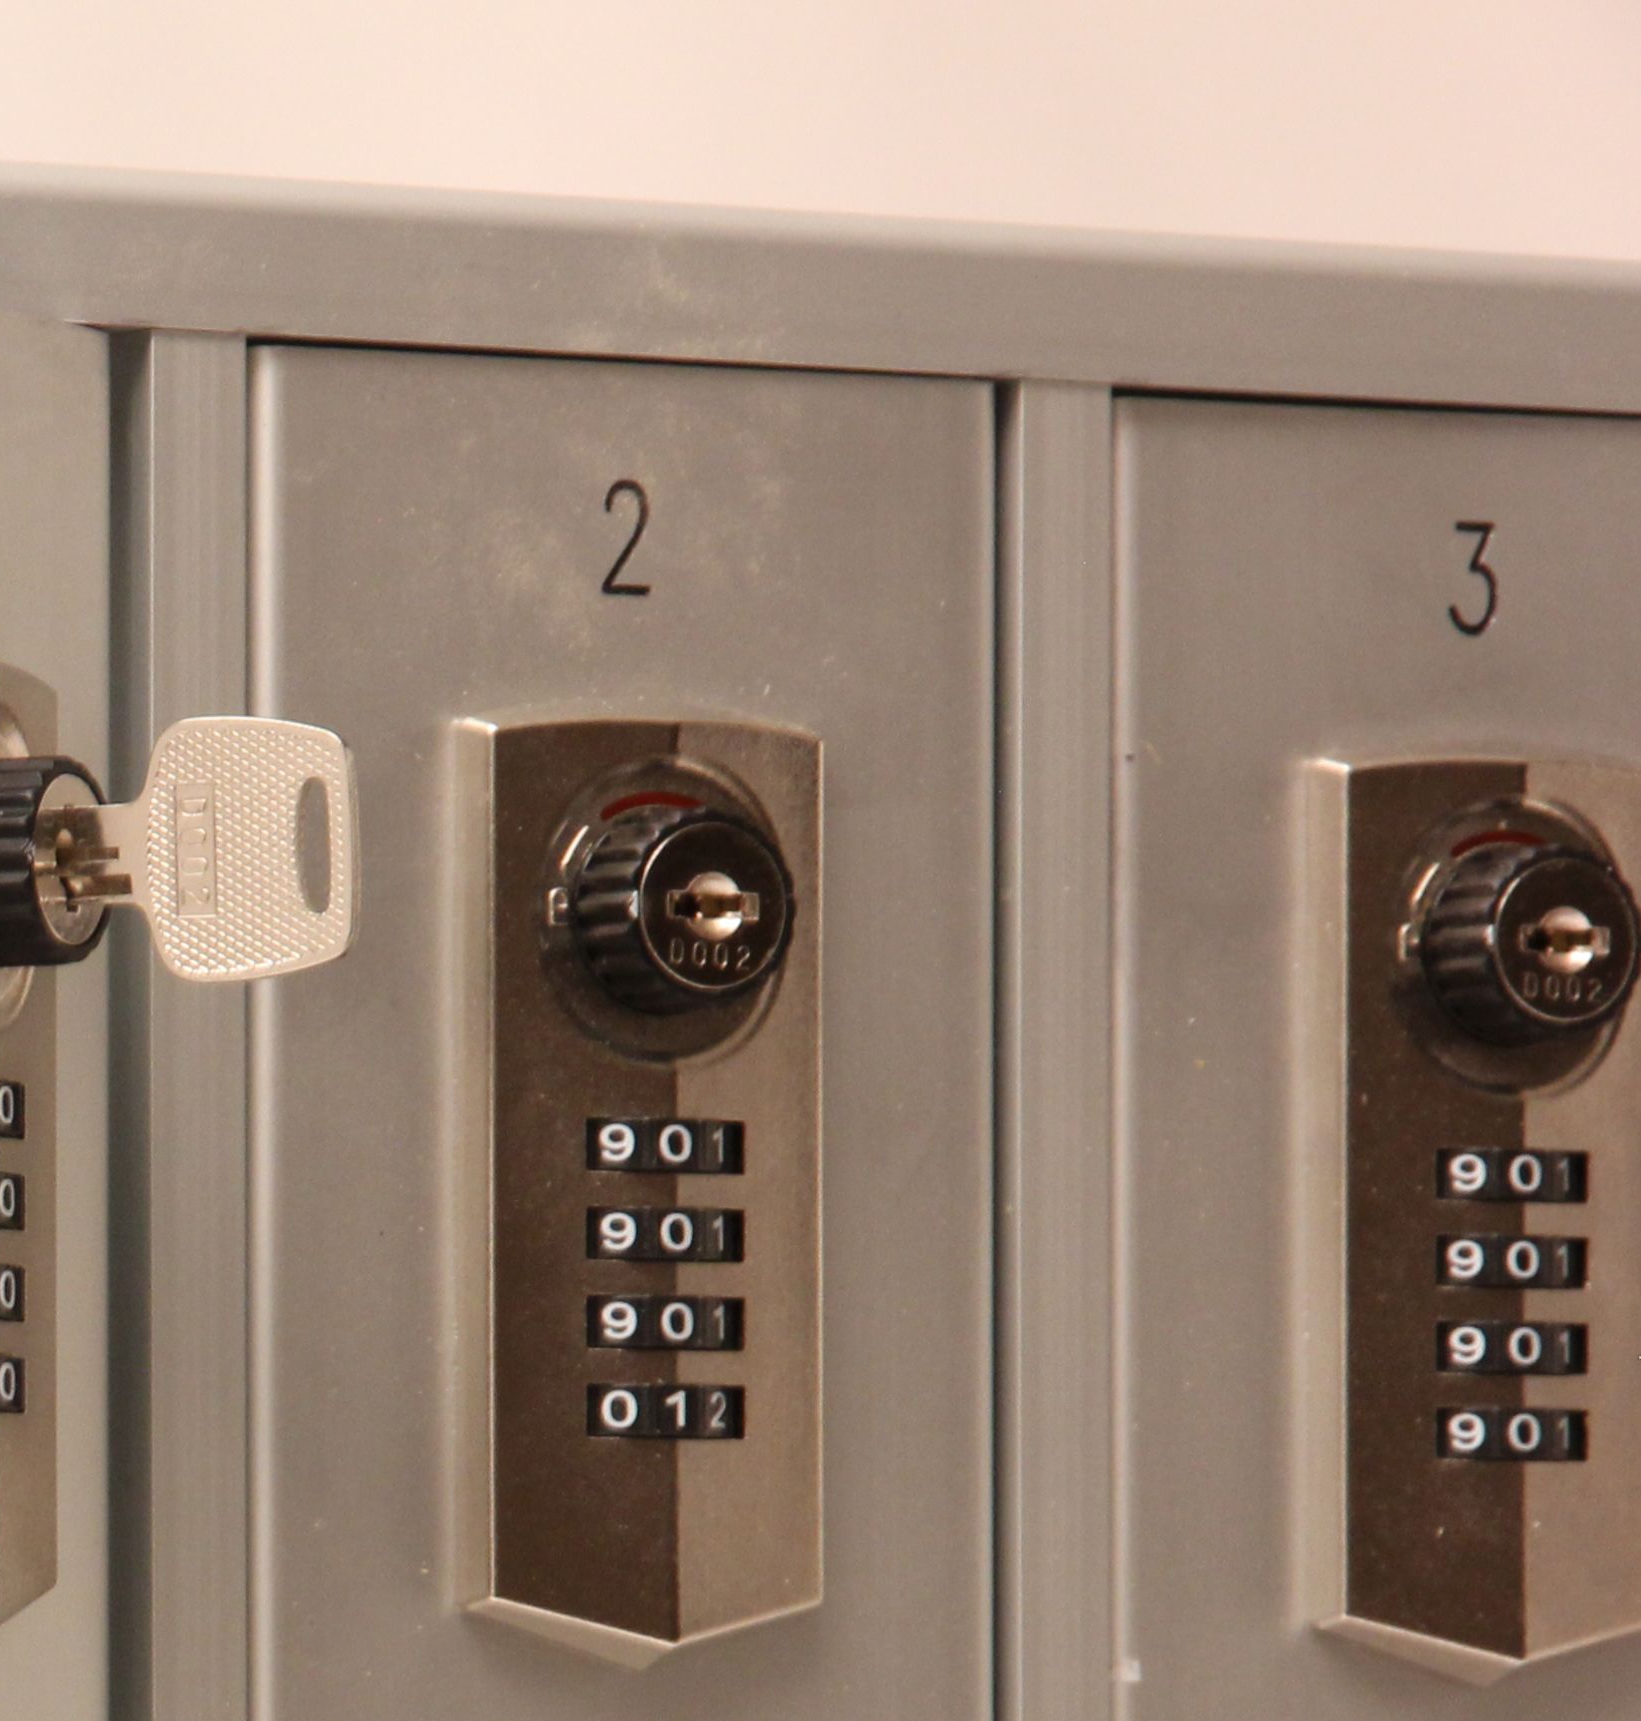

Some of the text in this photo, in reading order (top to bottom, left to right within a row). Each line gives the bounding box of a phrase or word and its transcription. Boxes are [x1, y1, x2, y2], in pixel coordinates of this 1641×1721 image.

[602, 479, 650, 595] 2
[1449, 521, 1498, 637] 3
[598, 1123, 724, 1164] 901
[599, 1212, 725, 1253] 901
[600, 1301, 725, 1340] 901
[601, 1389, 727, 1429] 012
